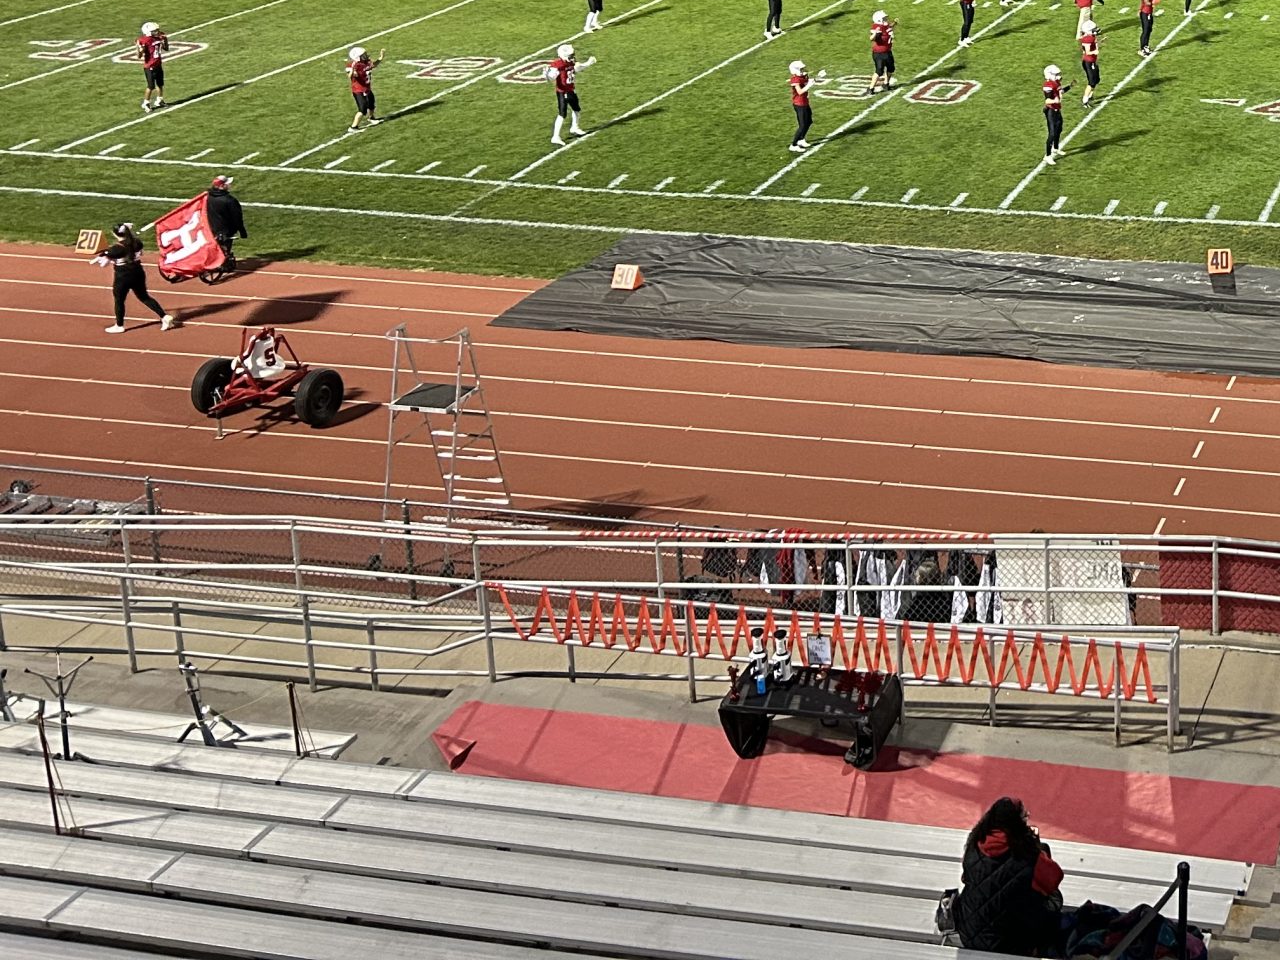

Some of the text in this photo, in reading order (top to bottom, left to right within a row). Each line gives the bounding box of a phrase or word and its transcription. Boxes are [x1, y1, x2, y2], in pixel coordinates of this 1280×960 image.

[77, 231, 99, 250] 20
[1210, 250, 1229, 270] 40
[615, 267, 635, 285] 30
